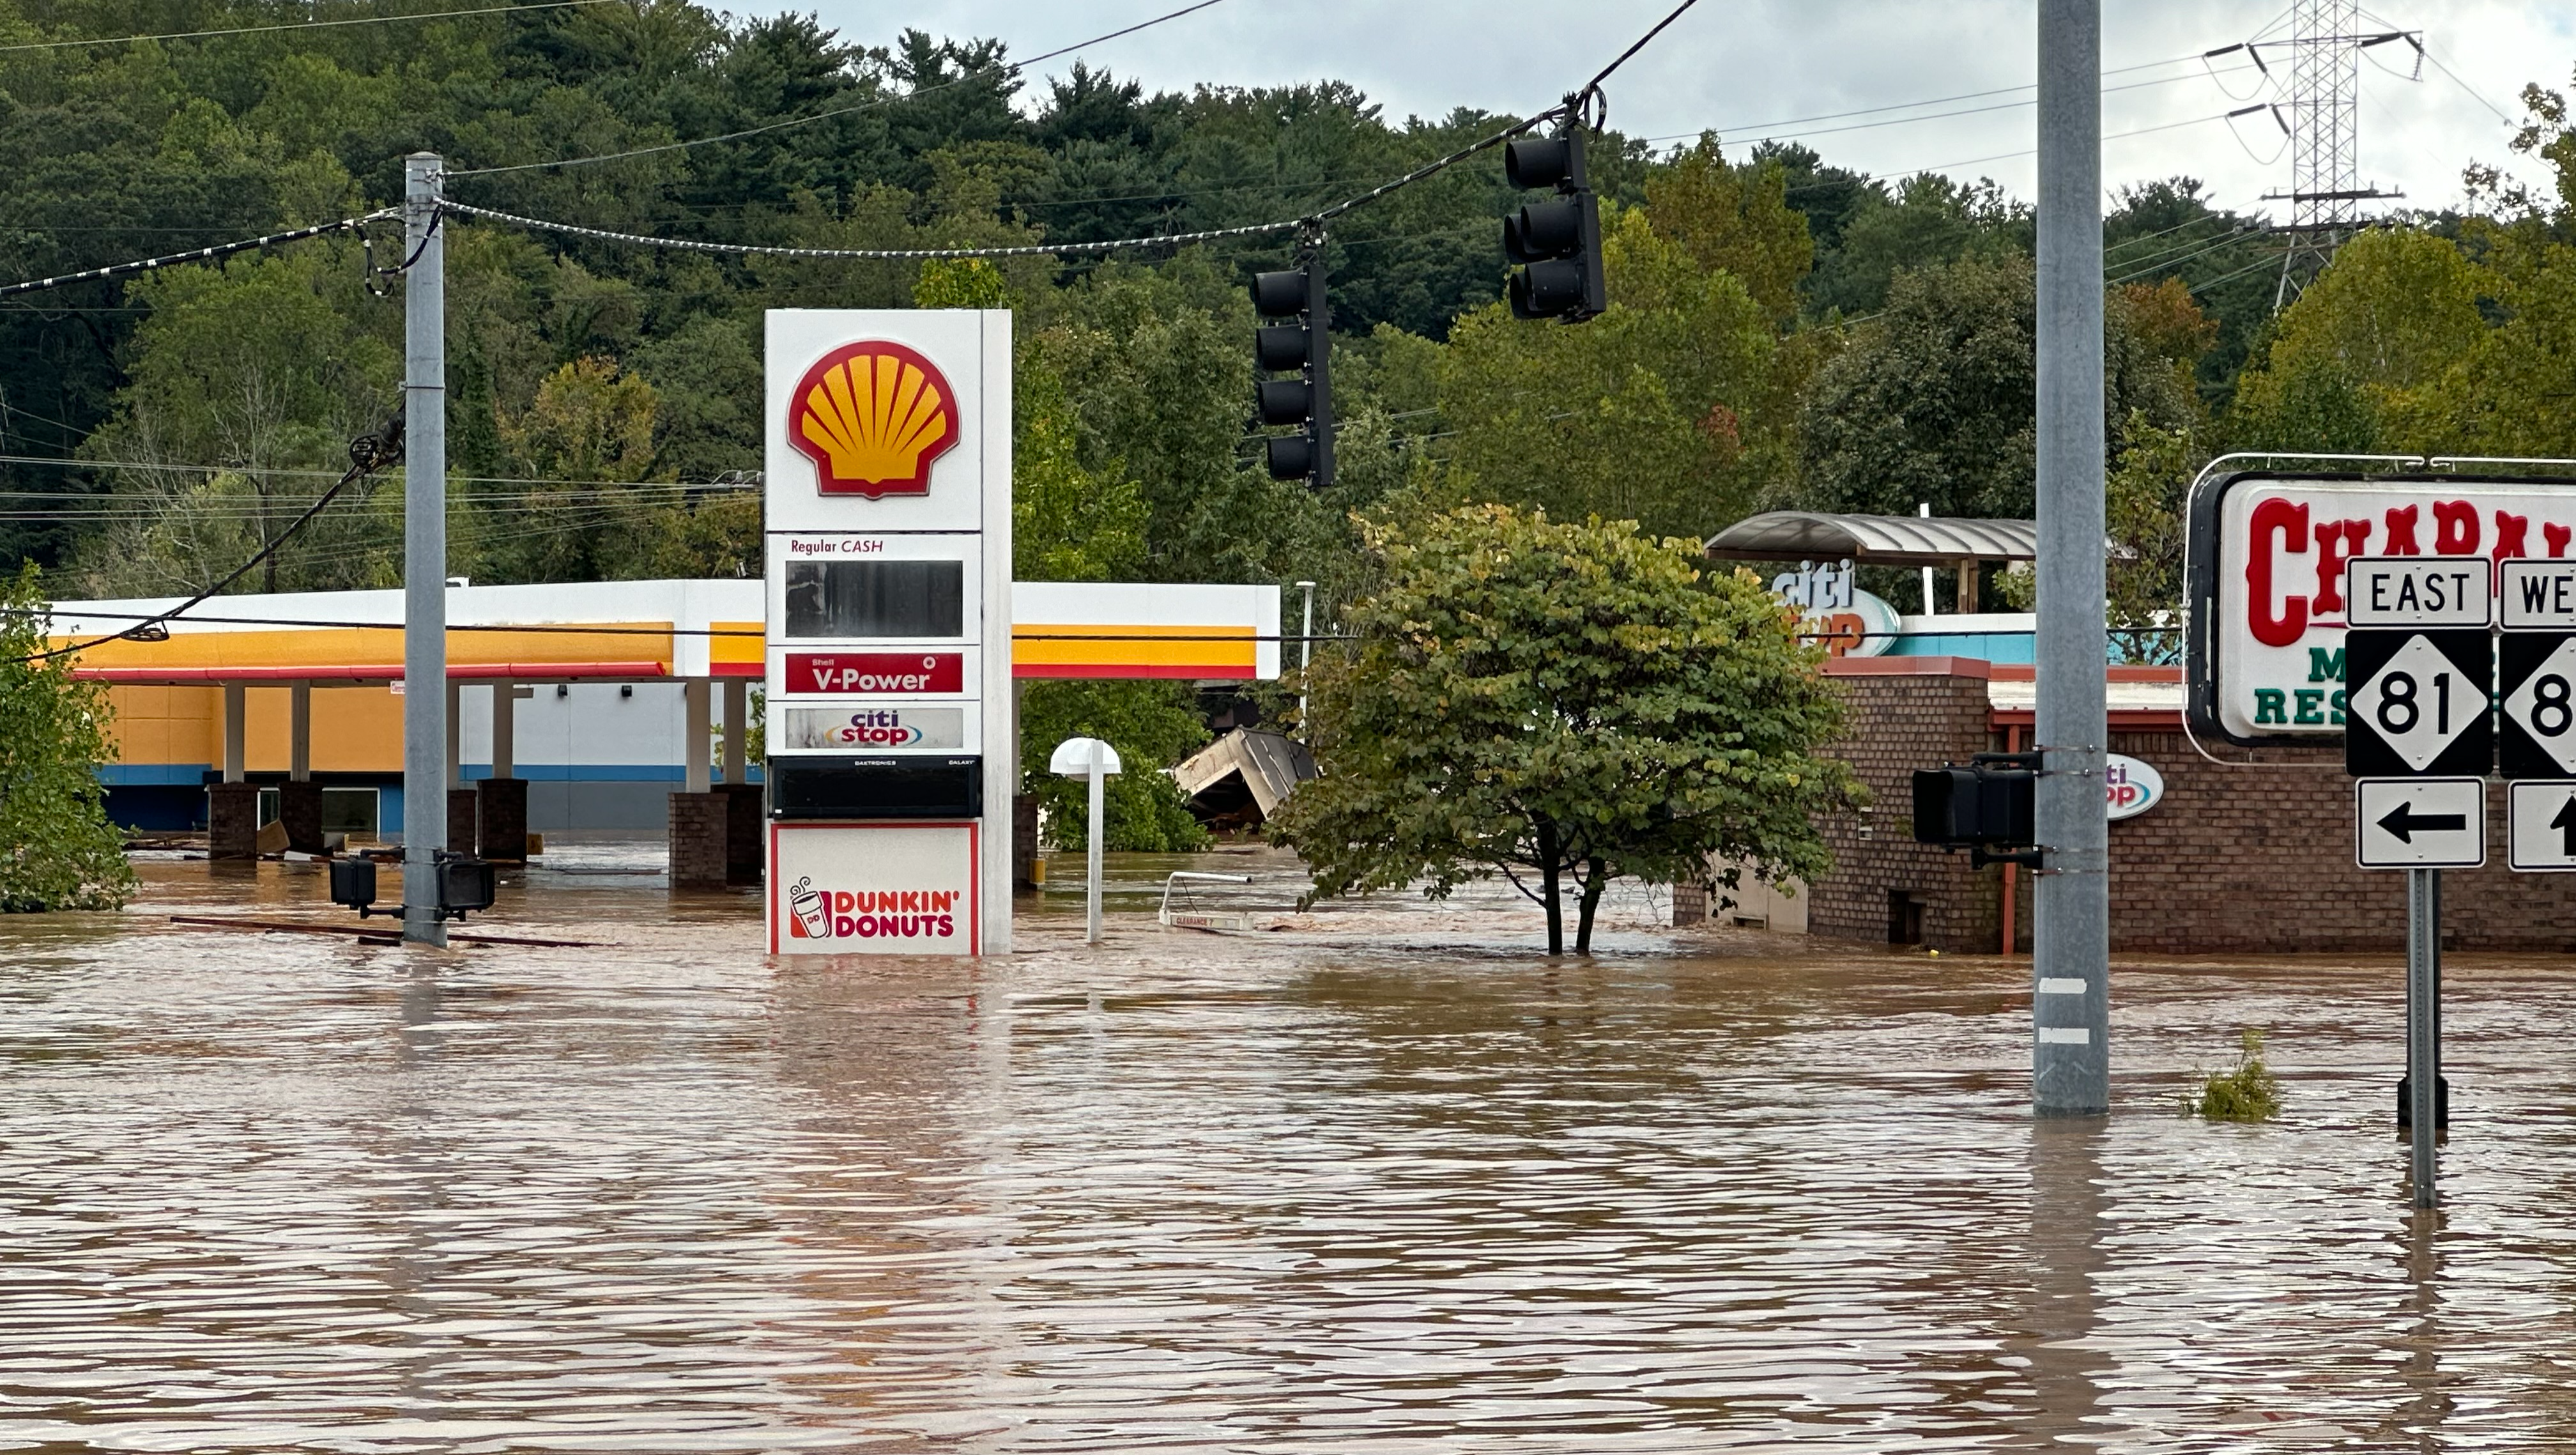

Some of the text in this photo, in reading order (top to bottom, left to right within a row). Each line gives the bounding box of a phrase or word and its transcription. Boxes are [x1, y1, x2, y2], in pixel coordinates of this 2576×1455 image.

[791, 539, 884, 556] Regular CASH
[2372, 573, 2470, 612] EAST
[812, 668, 931, 691] V-Power
[2377, 670, 2450, 735] 81
[850, 709, 899, 727] citi
[841, 725, 909, 746] stop
[835, 890, 960, 914] DUNKIN'
[835, 914, 954, 938] DONUTS
